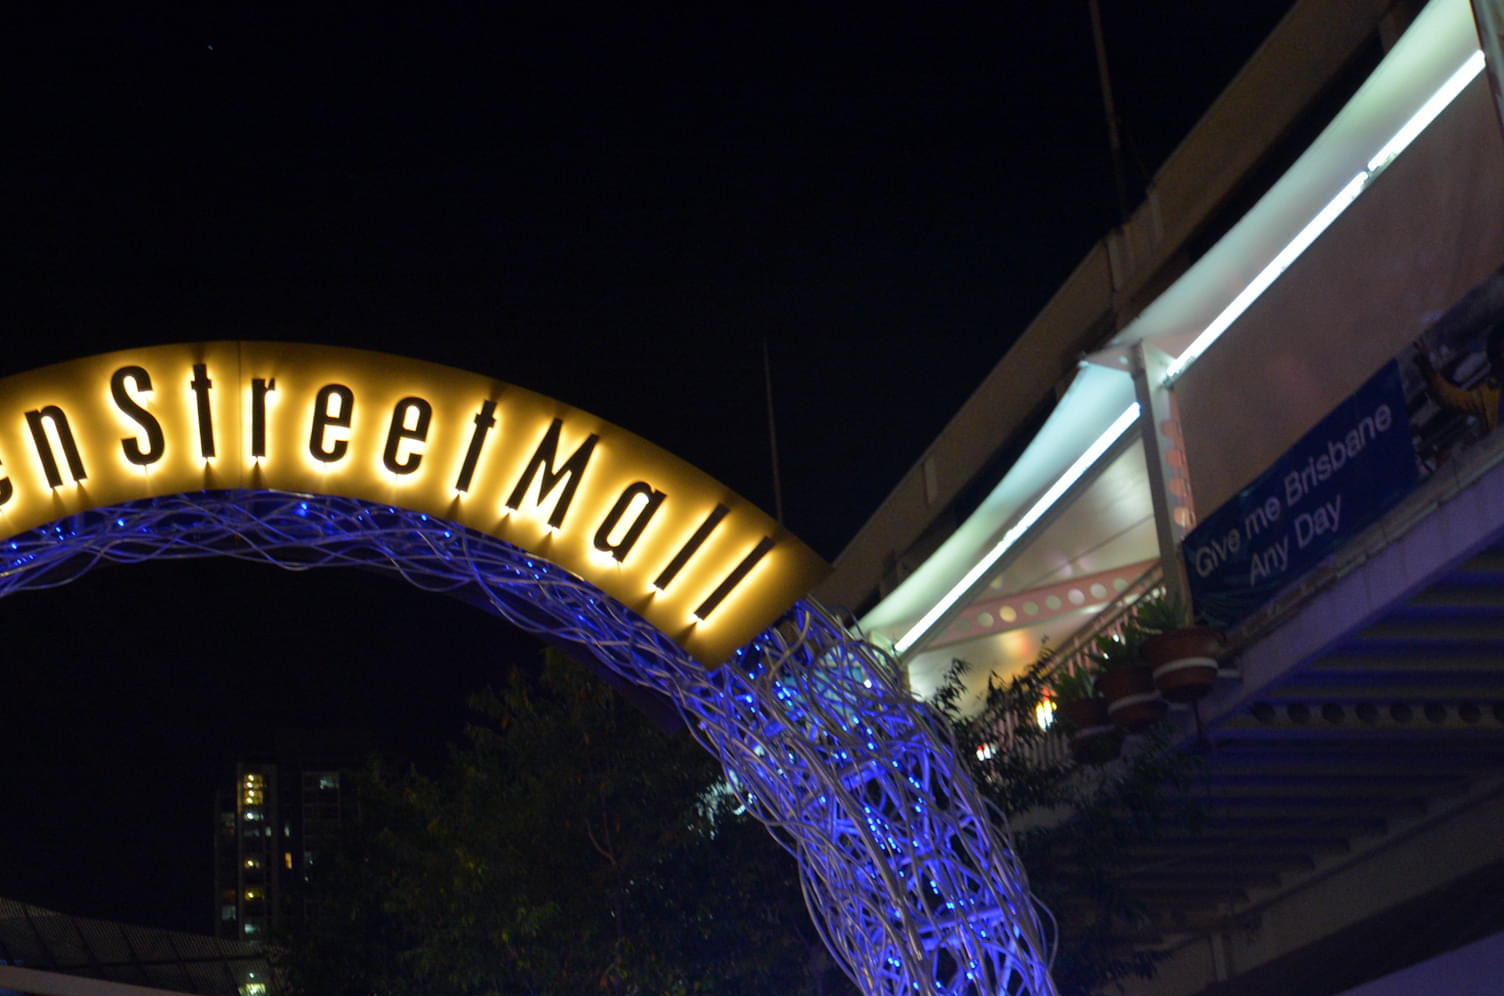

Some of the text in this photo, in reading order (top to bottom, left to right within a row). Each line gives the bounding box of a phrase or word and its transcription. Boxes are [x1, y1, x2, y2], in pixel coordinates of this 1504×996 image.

[110, 362, 497, 494] Street
[505, 417, 777, 622] Mall
[1195, 404, 1392, 579] Give me Brisbane
[1248, 495, 1342, 585] Any Day
